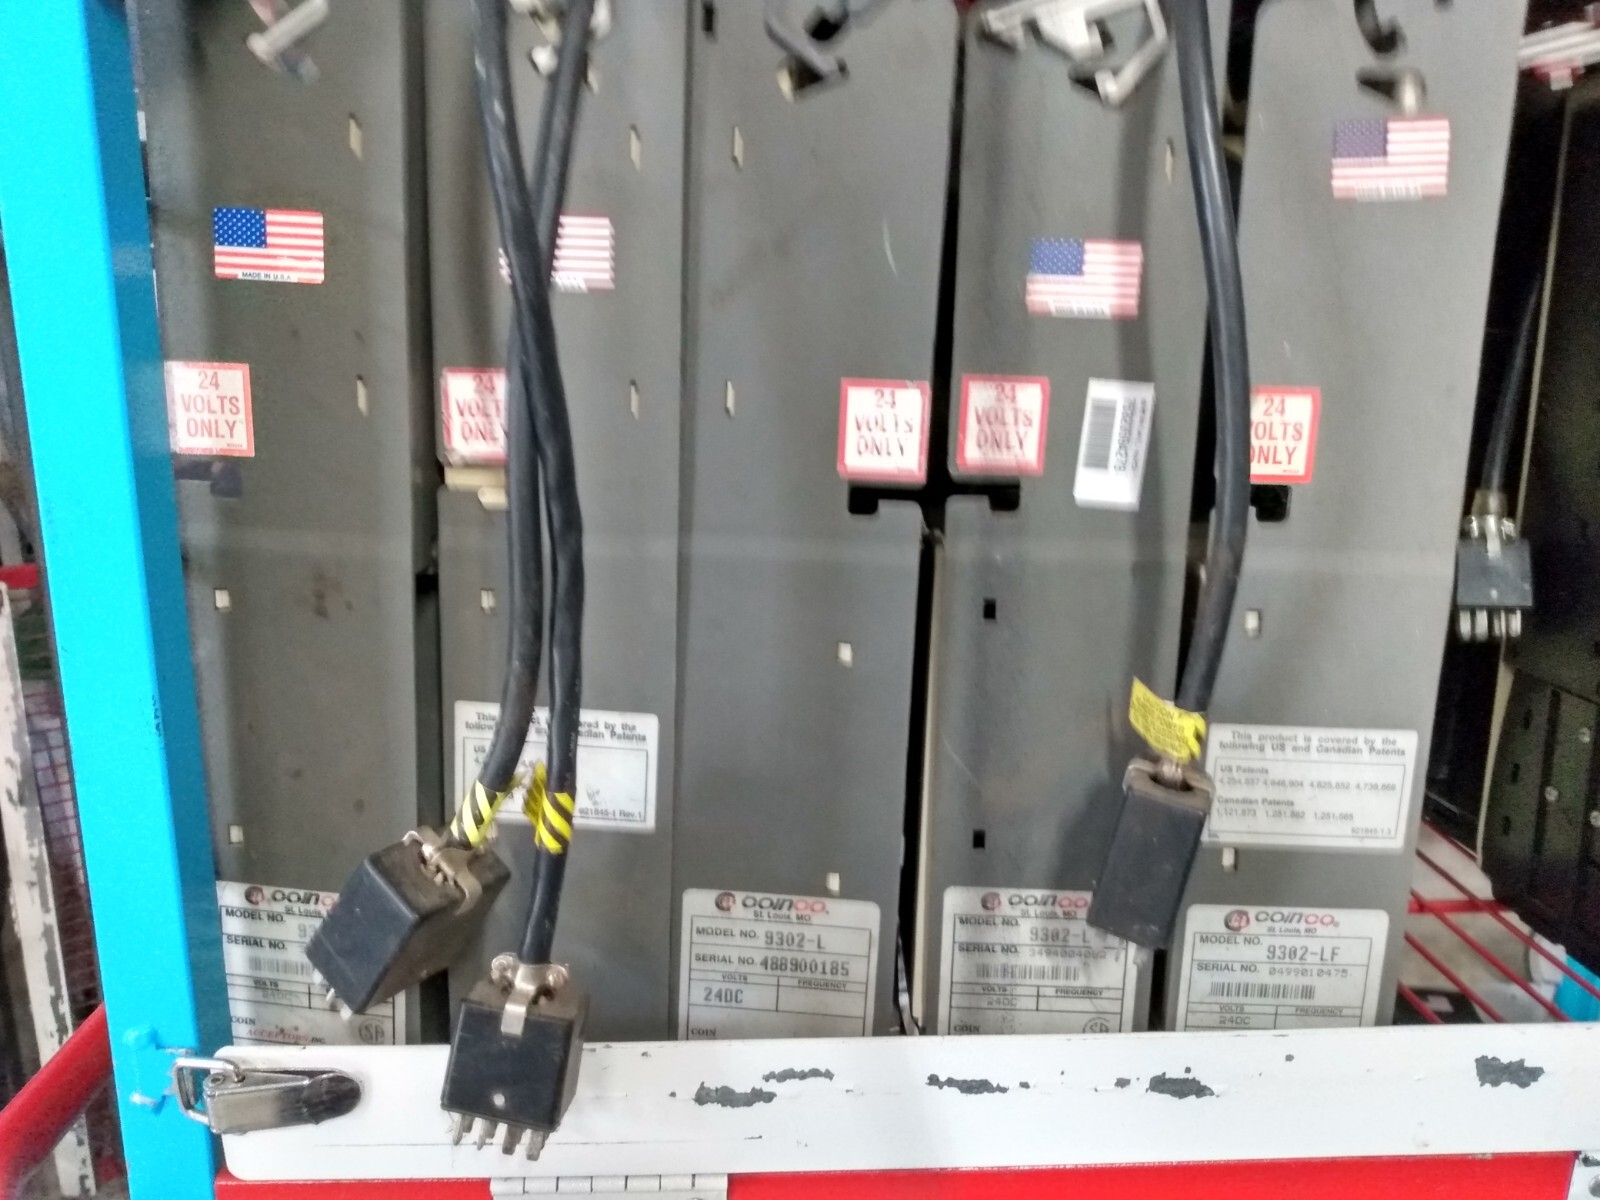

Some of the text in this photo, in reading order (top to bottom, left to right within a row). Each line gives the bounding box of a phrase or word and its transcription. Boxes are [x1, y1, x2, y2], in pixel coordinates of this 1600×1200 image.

[242, 271, 261, 279] MADE
[263, 272, 271, 280] IN
[198, 370, 221, 391] 24
[874, 388, 897, 409] 24
[994, 383, 1018, 404] 24
[180, 393, 241, 416] VOLTS
[454, 397, 503, 418] VOLT
[1262, 395, 1287, 417] 24
[854, 412, 914, 434] VOLTS
[974, 405, 1034, 428] VOLTS
[187, 417, 238, 440] ONLY
[461, 420, 503, 443] ONL
[857, 434, 906, 457] ONLY
[976, 427, 1029, 451] ONLY
[476, 711, 497, 721] This
[604, 721, 617, 731] by
[621, 723, 636, 731] the
[465, 721, 494, 731] follow
[610, 730, 647, 742] Patents
[1231, 729, 1252, 740] This
[1258, 732, 1298, 744] product
[1318, 736, 1359, 745] covered
[1364, 737, 1376, 747] by
[1382, 738, 1397, 746] the
[1219, 740, 1406, 756] following US and Canadian Patents
[1220, 764, 1269, 774] US Patents
[1217, 795, 1295, 807] Canadian Patents
[741, 895, 827, 914] coinco
[1007, 893, 1089, 909] coinco
[225, 907, 287, 924] MODEL NO.
[795, 913, 812, 922] MO
[958, 917, 998, 928] MODEL
[1001, 919, 1021, 928] NO.
[1062, 910, 1077, 918] MO
[1254, 910, 1336, 926] coinco
[226, 935, 289, 951] SERIAL NO.
[695, 926, 827, 951] MODEL NO. 9302-L
[957, 943, 998, 954] SERIAL
[1001, 945, 1020, 955] NO.
[1199, 934, 1341, 963] MODEL NO. 9302-LF
[694, 953, 851, 977] SERIAL NO. 488900185
[1196, 962, 1237, 973] SERIAL
[1240, 964, 1261, 974] NO.
[253, 979, 280, 988] VOLTS
[721, 973, 848, 991] VOLTS FREQUENCY
[703, 986, 744, 1005] 24DC
[981, 986, 1104, 997] VOLTS FREQUENCY
[1219, 1005, 1344, 1016] VOLTS FREQUENCY
[231, 1015, 256, 1026] COIN
[953, 1024, 980, 1034] COIN
[1219, 1016, 1251, 1026] 24DC
[690, 1028, 717, 1038] COIN
